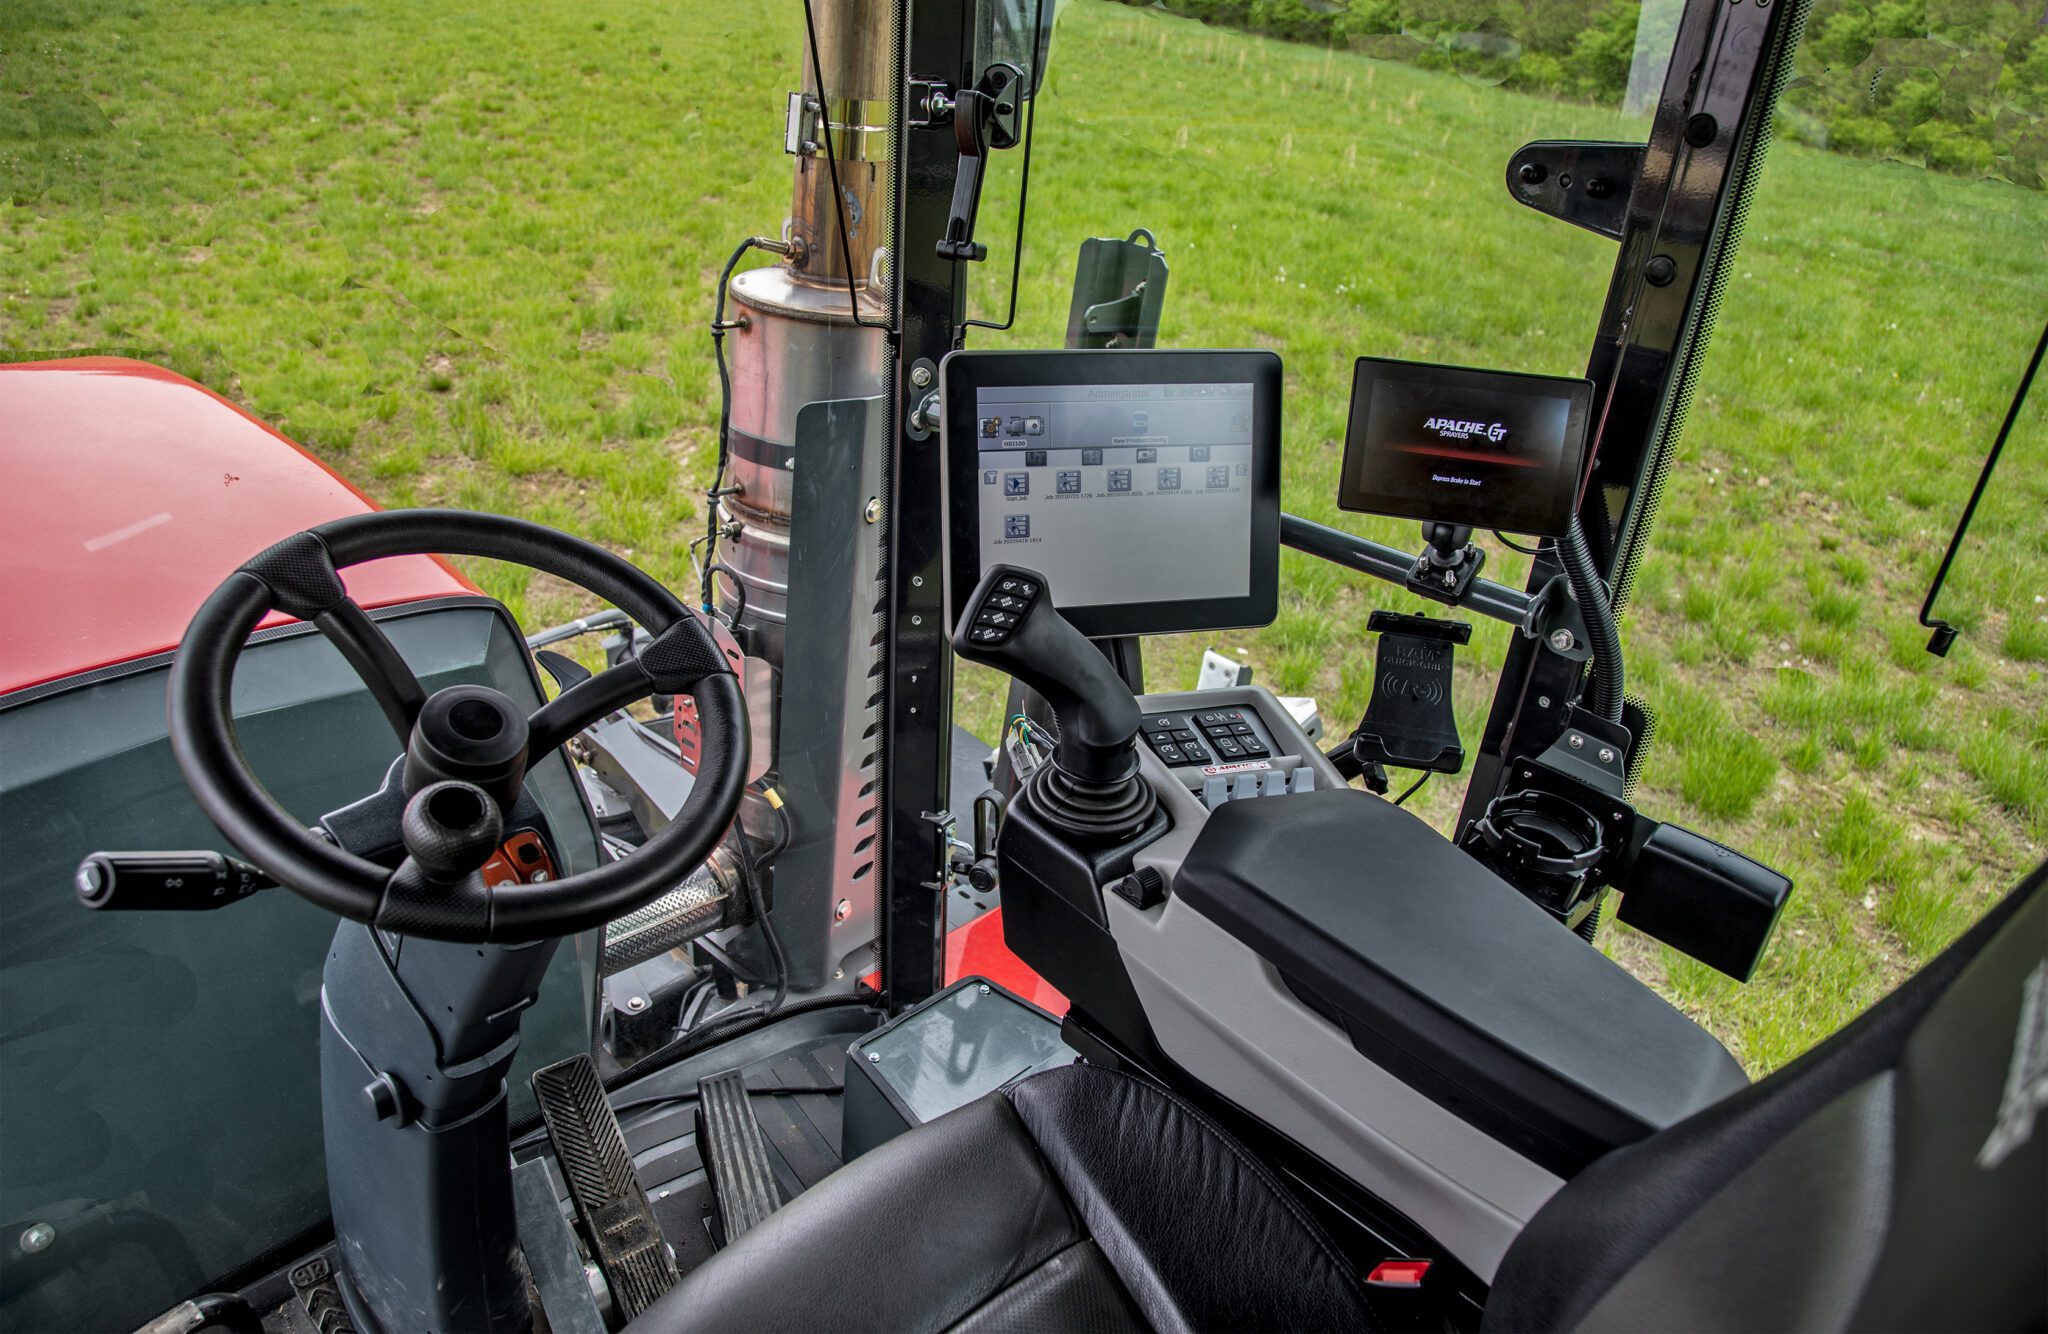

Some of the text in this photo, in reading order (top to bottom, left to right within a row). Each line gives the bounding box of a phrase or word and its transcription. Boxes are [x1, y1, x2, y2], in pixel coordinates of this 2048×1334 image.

[1088, 389, 1150, 399] Administrator
[1423, 417, 1508, 443] APACHE GT
[1439, 429, 1469, 440] SPRAYERS
[1432, 474, 1450, 483] Depress
[1450, 476, 1464, 484] Brake
[1470, 478, 1482, 486] Start
